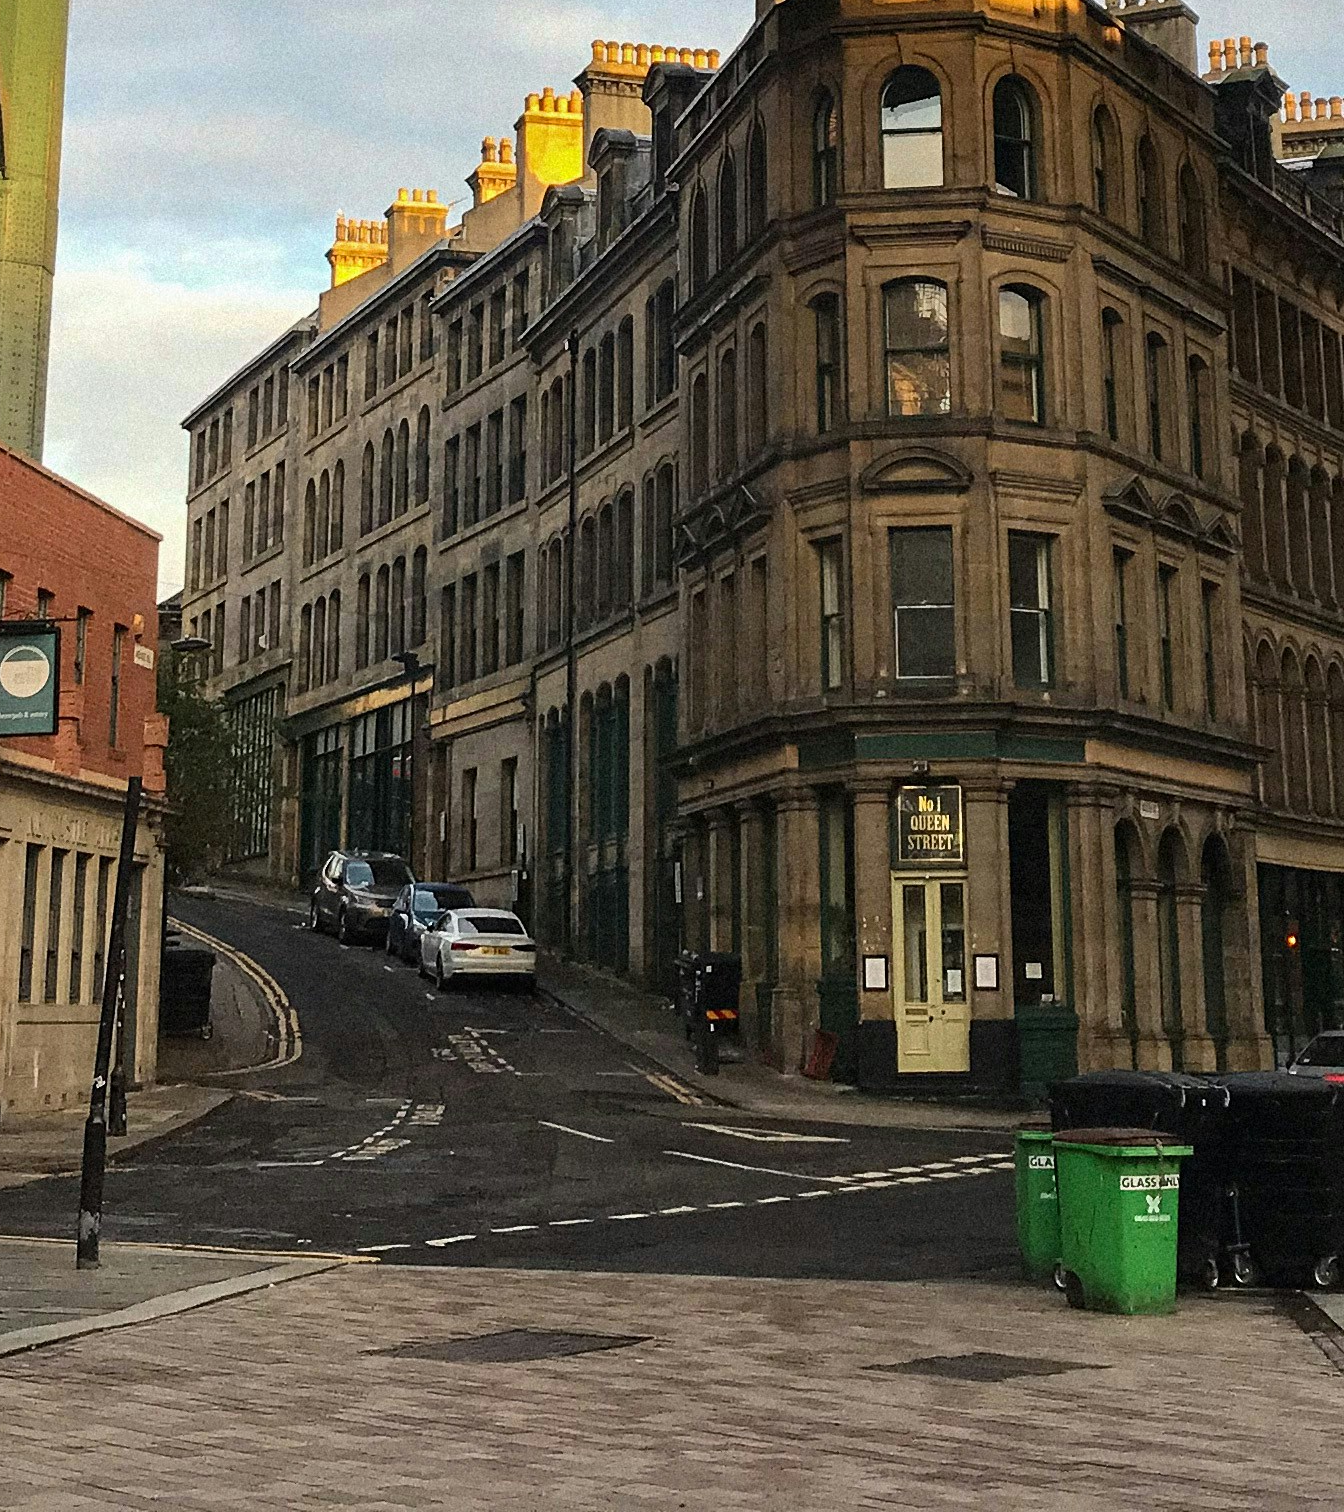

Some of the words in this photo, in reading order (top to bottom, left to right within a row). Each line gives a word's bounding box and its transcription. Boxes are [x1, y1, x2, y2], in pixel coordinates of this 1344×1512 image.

[918, 795, 934, 812] No
[910, 814, 950, 831] QUEEN
[907, 834, 954, 850] STREET
[1030, 1157, 1054, 1167] GLA
[1121, 1177, 1156, 1188] GLASS
